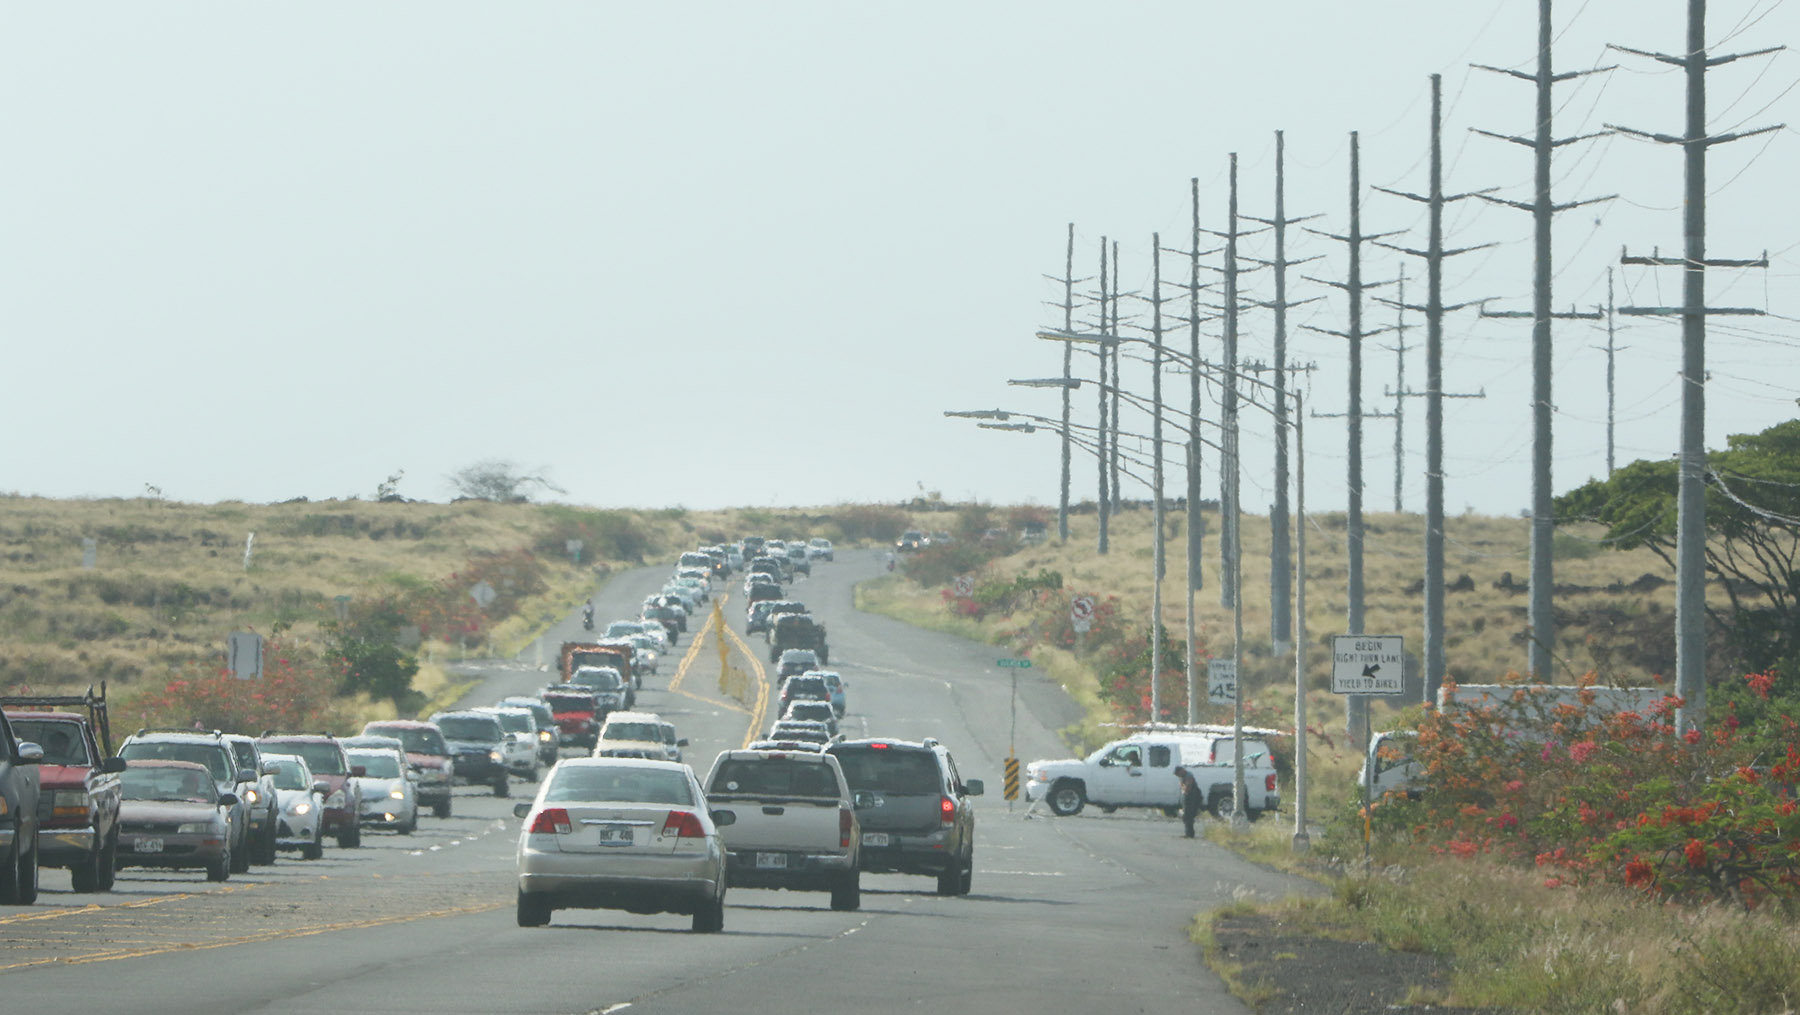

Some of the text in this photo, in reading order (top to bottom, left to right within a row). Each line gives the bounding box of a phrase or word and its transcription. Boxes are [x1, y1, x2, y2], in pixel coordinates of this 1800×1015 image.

[1355, 641, 1382, 651] BEGIN
[1336, 653, 1358, 663] RIGHT
[1361, 654, 1379, 663] TURN
[1339, 679, 1398, 688] YIELD TO BIKES
[1210, 683, 1236, 699] 45
